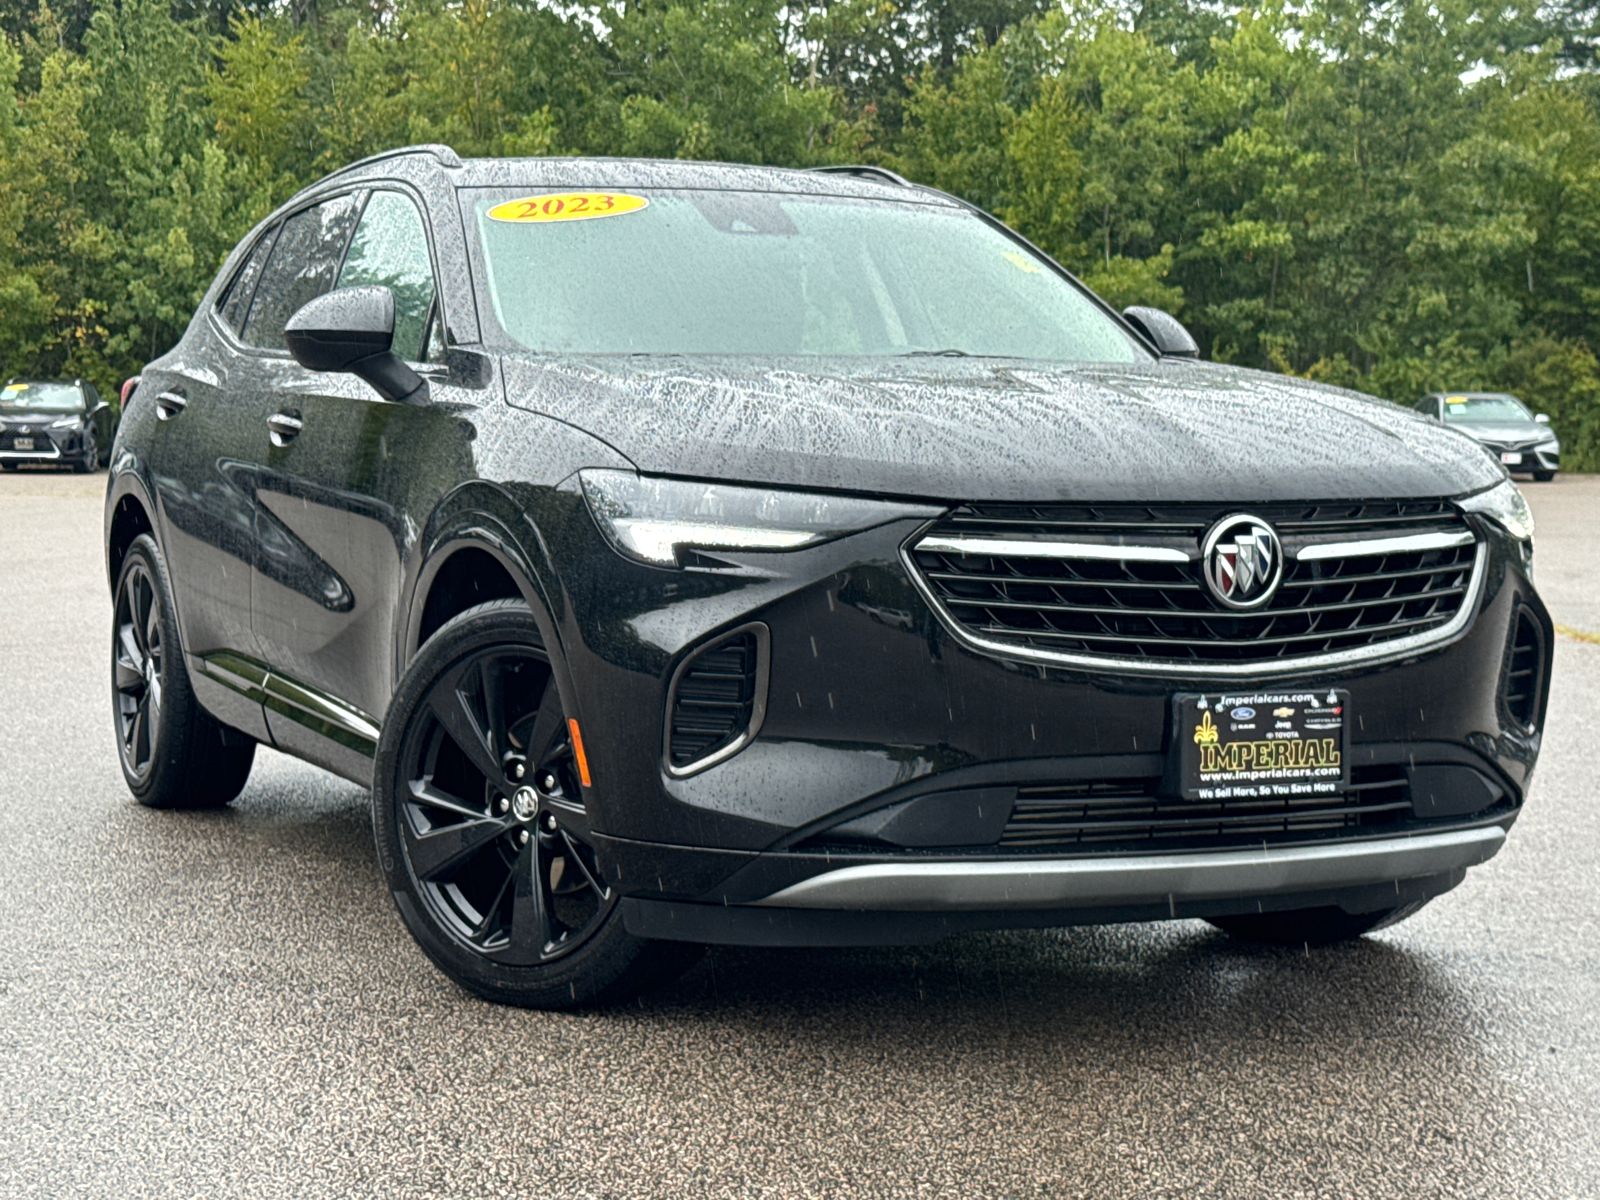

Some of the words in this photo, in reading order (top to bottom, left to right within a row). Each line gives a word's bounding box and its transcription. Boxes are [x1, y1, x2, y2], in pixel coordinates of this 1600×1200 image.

[517, 194, 614, 218] 2023
[1275, 721, 1291, 730] Jeep
[1275, 731, 1299, 739] TOYOTA
[1200, 738, 1341, 772] IMPERIAL
[1200, 767, 1340, 781] www.imperialcars.com
[1198, 788, 1214, 799] We
[1215, 788, 1231, 798] Sell
[1233, 787, 1258, 797] More,
[1259, 785, 1271, 795] So
[1273, 784, 1290, 794] You
[1291, 783, 1312, 793] Save
[1314, 782, 1336, 792] More
